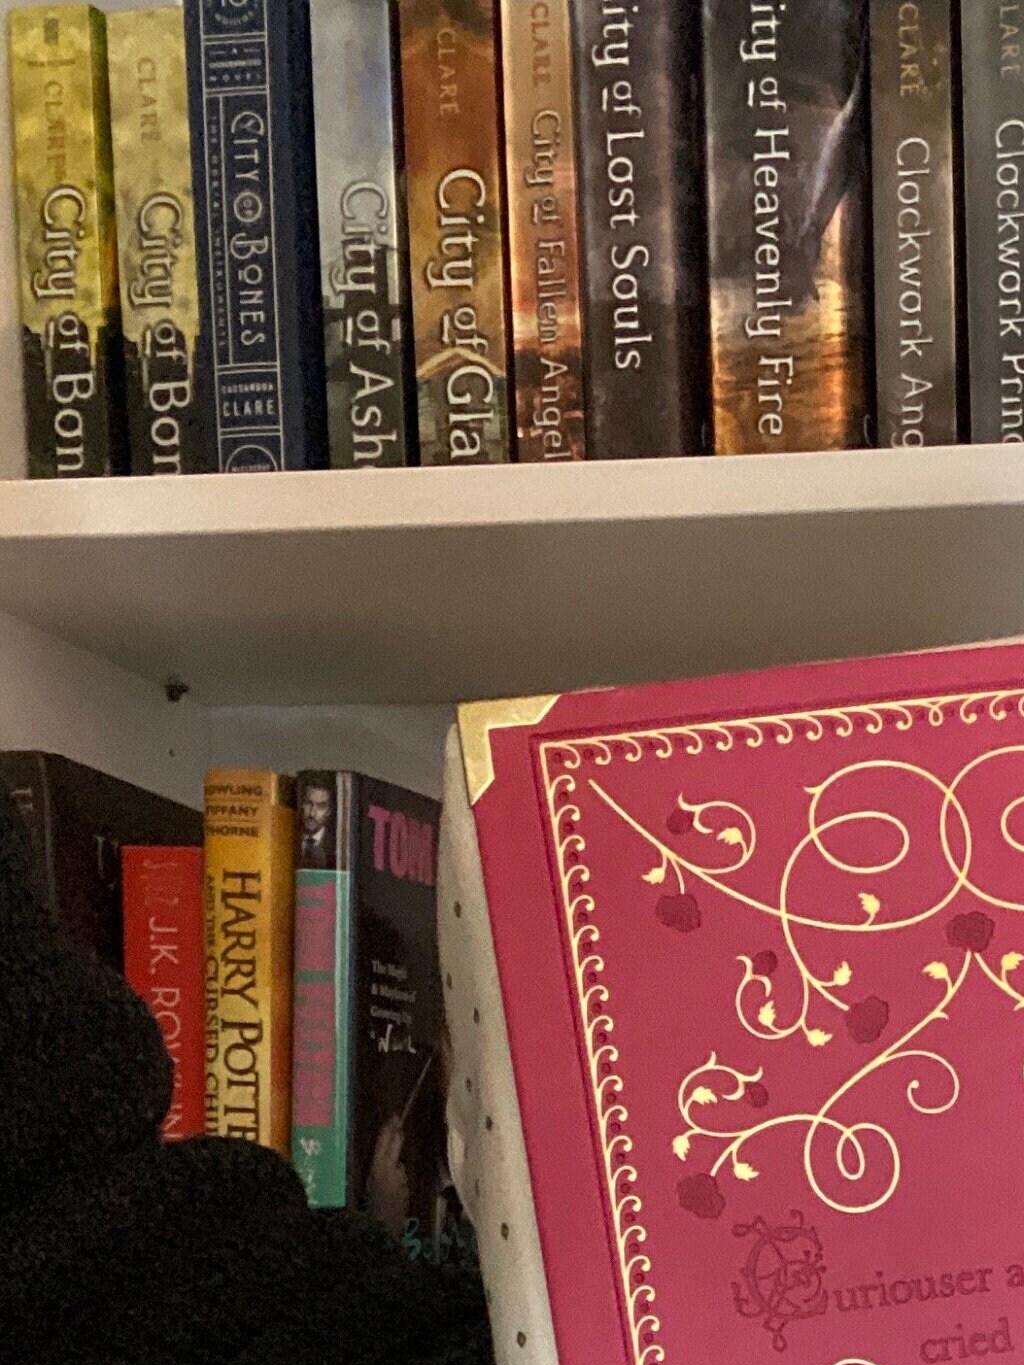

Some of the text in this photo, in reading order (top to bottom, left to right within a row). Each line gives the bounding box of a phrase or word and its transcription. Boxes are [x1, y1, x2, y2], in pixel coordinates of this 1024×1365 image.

[434, 28, 460, 117] CLARE
[530, 2, 550, 87] CLARE
[899, 3, 921, 97] CLARE
[231, 111, 265, 181] CITY
[592, 0, 653, 370] ity of Lost Souls
[34, 184, 86, 301] City
[130, 191, 185, 360] City of
[740, 2, 793, 437] ity of Heavenly Fire
[896, 137, 934, 358] Clockwork
[48, 311, 89, 351] of
[229, 233, 269, 345] BONES
[331, 181, 396, 460] City of Ash
[427, 168, 495, 460] City of Gla
[526, 109, 573, 461] City of Fallen Angel
[222, 400, 276, 417] CLARE
[149, 915, 179, 976] J.K.
[220, 869, 262, 1010] HARRY
[205, 954, 220, 1064] CURSED
[919, 1317, 1014, 1365] cried
